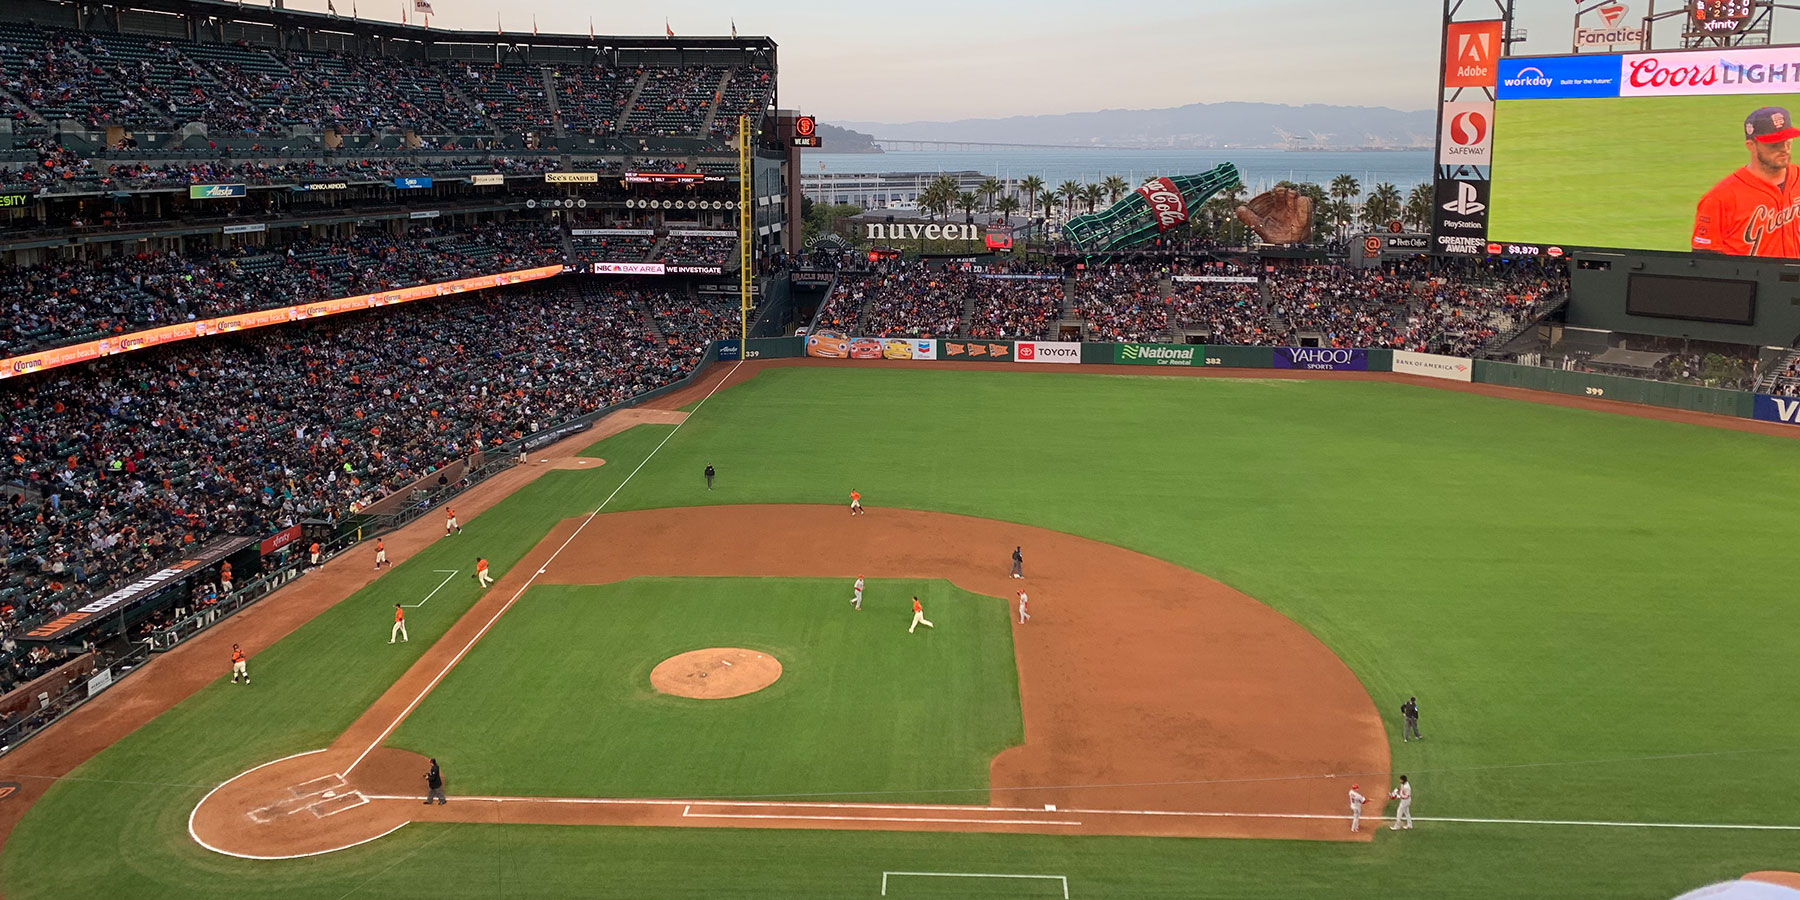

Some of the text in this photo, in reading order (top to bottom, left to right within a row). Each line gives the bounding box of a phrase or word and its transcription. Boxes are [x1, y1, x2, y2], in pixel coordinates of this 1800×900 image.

[1704, 20, 1739, 32] xfinity
[1577, 28, 1643, 44] Fanatics
[1457, 65, 1488, 77] Adobe
[1629, 57, 1800, 88] Coors LIGHT
[1504, 76, 1553, 88] workday
[1449, 146, 1485, 155] SAFEWAY
[547, 173, 567, 182] See's
[866, 222, 980, 241] nuveen
[1438, 235, 1486, 247] GREATNESS
[596, 264, 612, 272] NBC
[639, 265, 663, 273] AREA
[666, 265, 722, 274] WE INVESTIGATE
[217, 319, 241, 331] Corona
[242, 317, 255, 328] Find
[120, 327, 193, 350] Corona Find your beach.
[745, 350, 760, 358] 339
[1038, 347, 1078, 357] TOYOTA
[1138, 346, 1195, 360] National
[1289, 347, 1354, 364] YAHOO!
[13, 347, 97, 373] Corona Find your beach.
[1157, 358, 1169, 366] Car
[1205, 357, 1221, 365] 382
[1396, 358, 1412, 366] BANK
[1422, 361, 1453, 371] AMERICA
[1307, 363, 1334, 371] SPORTS
[1586, 386, 1604, 396] 399
